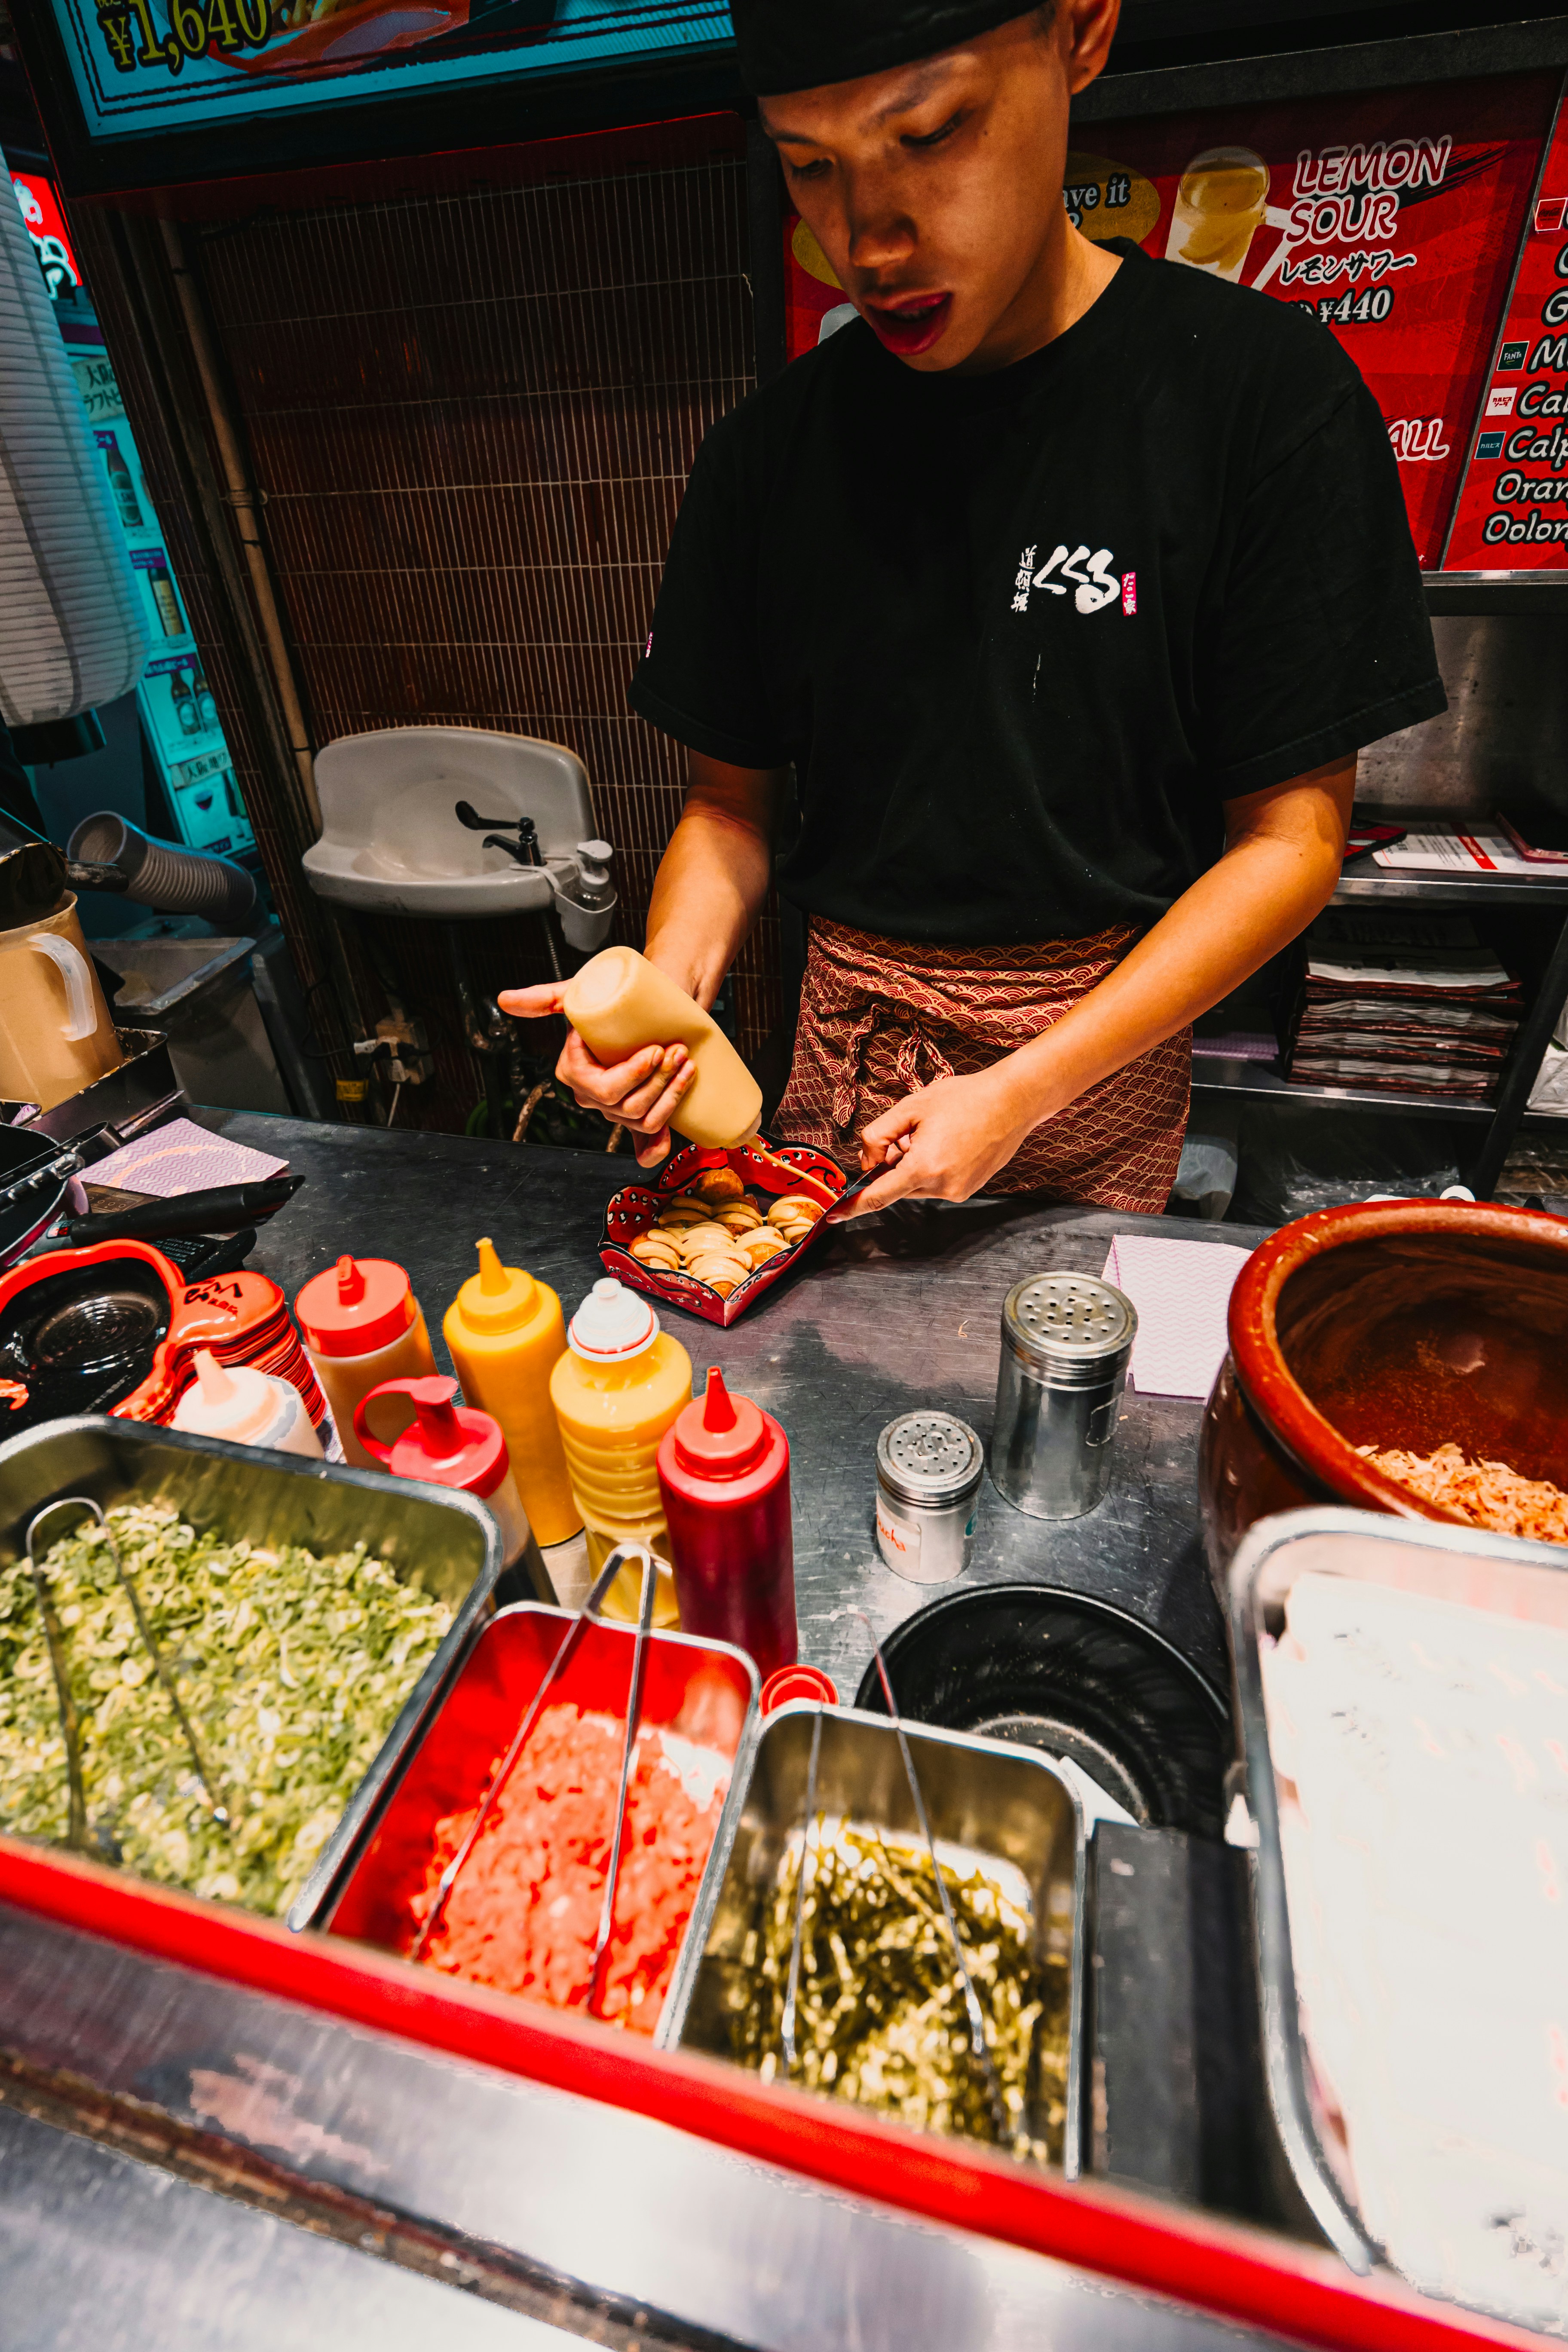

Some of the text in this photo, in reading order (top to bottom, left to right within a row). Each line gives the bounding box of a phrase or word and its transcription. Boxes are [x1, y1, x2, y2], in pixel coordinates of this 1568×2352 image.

[1292, 135, 1452, 199] LEMON
[1108, 177, 1128, 204] it
[1283, 190, 1400, 245] SOUR
[1280, 249, 1417, 286] レモンサワー
[1320, 289, 1391, 323] ¥440
[1032, 545, 1121, 614] くくる
